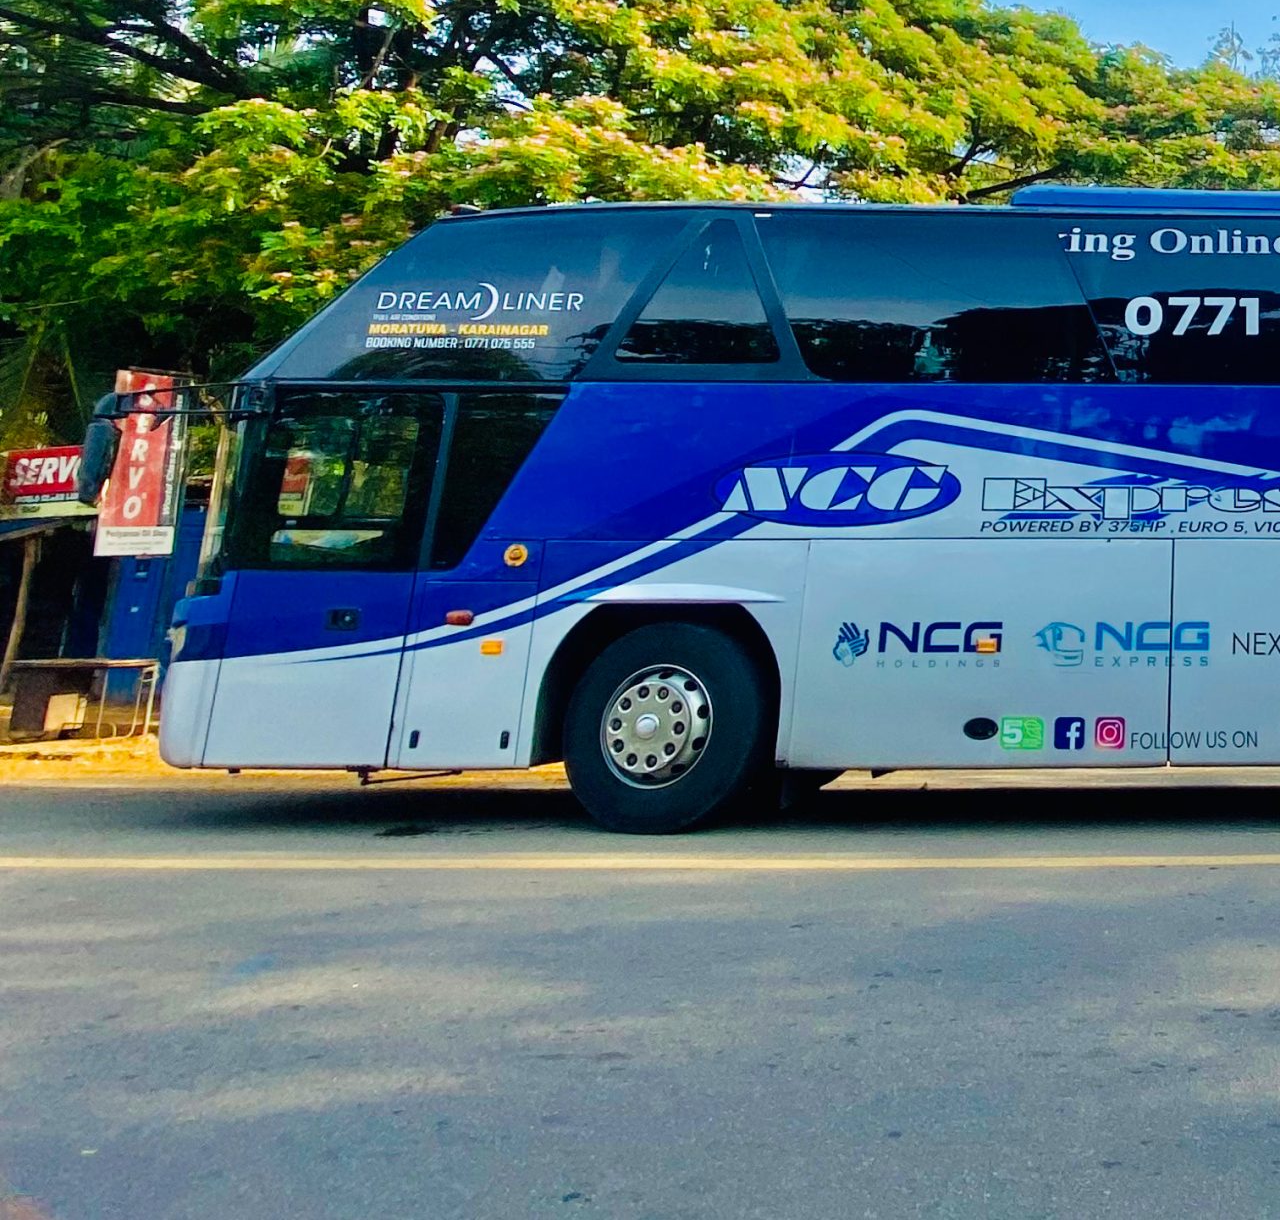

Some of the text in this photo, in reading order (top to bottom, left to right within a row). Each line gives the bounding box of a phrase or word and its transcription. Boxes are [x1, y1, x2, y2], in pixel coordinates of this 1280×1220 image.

[1124, 296, 1260, 336] 0771
[368, 323, 447, 336] MORATUWA
[457, 324, 549, 336] KARAINAGAR
[365, 337, 411, 349] BOOKING
[464, 338, 489, 349] 0771
[490, 338, 511, 349] 075
[513, 338, 536, 349] 555
[720, 464, 949, 513] NCG
[979, 520, 1074, 533] POWERED
[1079, 520, 1104, 533] BY
[1108, 520, 1167, 533] 375HP
[1178, 520, 1228, 533] EURO
[878, 621, 1003, 653] NCG
[1094, 621, 1210, 652] NCG
[876, 659, 1001, 669] HOLDINGS
[1094, 656, 1210, 668] EXPRESS
[1130, 730, 1258, 750] FOLLOW US ON
